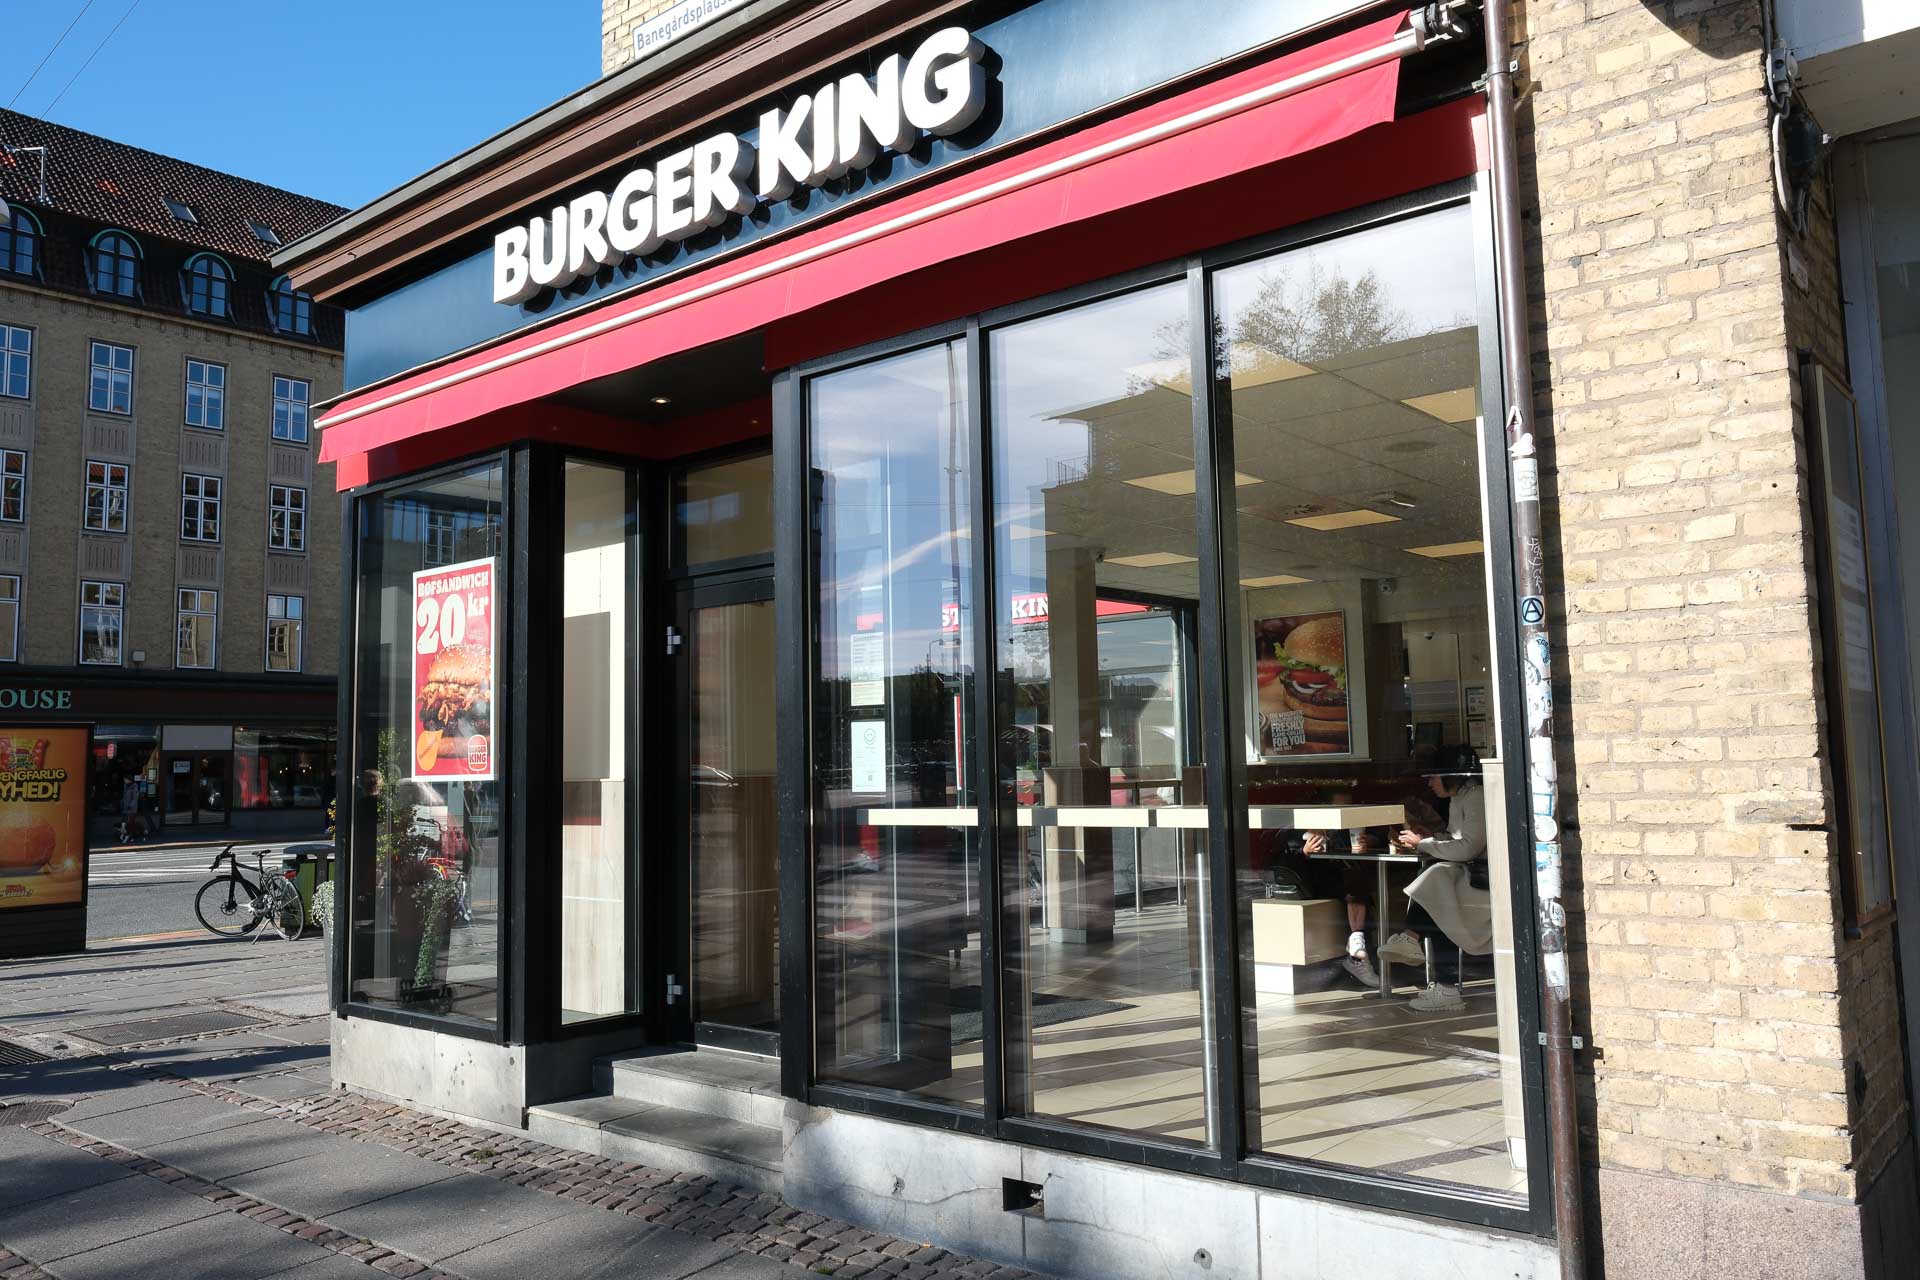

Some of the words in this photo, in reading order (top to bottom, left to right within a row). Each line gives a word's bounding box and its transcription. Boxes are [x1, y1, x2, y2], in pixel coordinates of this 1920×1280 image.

[493, 132, 742, 305] BURGER
[758, 27, 973, 197] KING
[417, 571, 488, 597] BØFSANDWICH
[417, 594, 466, 654] 20
[467, 593, 489, 616] kr
[0, 689, 72, 709] OUSE
